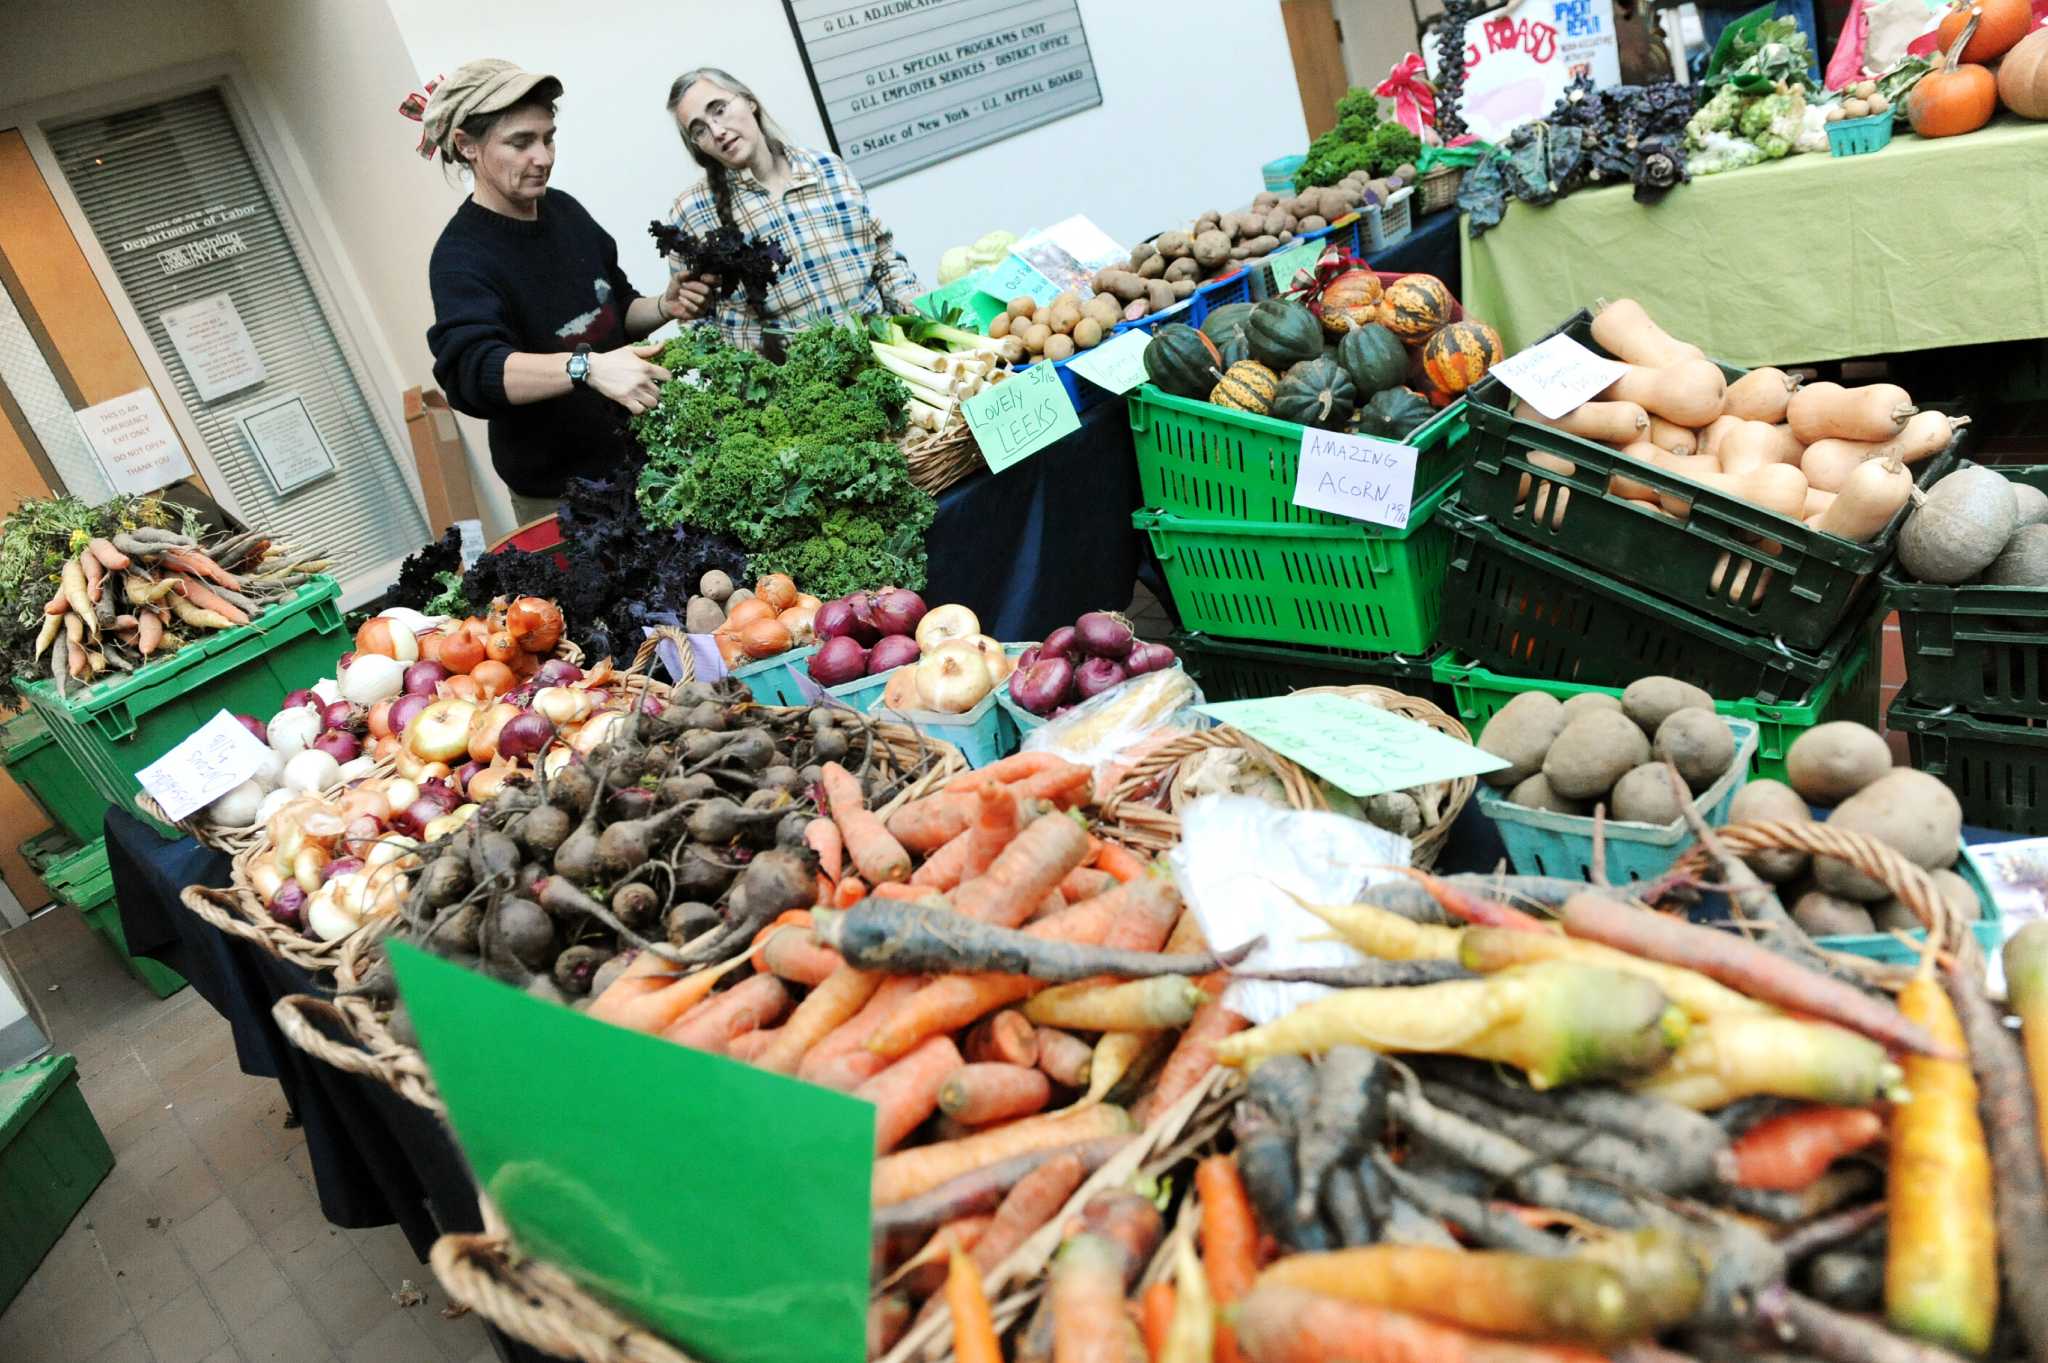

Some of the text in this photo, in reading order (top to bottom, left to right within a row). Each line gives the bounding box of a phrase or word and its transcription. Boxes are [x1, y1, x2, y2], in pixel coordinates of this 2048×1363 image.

[882, 77, 937, 102] EMPLOYER
[939, 62, 986, 84] SERVICES
[995, 44, 1038, 66] DISTRICT
[1039, 34, 1071, 52] OFFICE
[902, 52, 953, 75] SPECIAL
[956, 31, 1019, 59] PROGRAMS
[1020, 22, 1046, 38] UNIT
[863, 133, 897, 151] State
[901, 125, 913, 138] of
[917, 119, 940, 131] New
[944, 107, 970, 123] York
[1004, 82, 1044, 103] APPEAL
[1047, 69, 1084, 89] BOARD
[121, 205, 256, 252] Department of Labor
[188, 231, 242, 254] Helping
[996, 398, 1058, 454] LEEKS
[1310, 434, 1398, 468] AMAZING
[1318, 471, 1391, 501] ACORN
